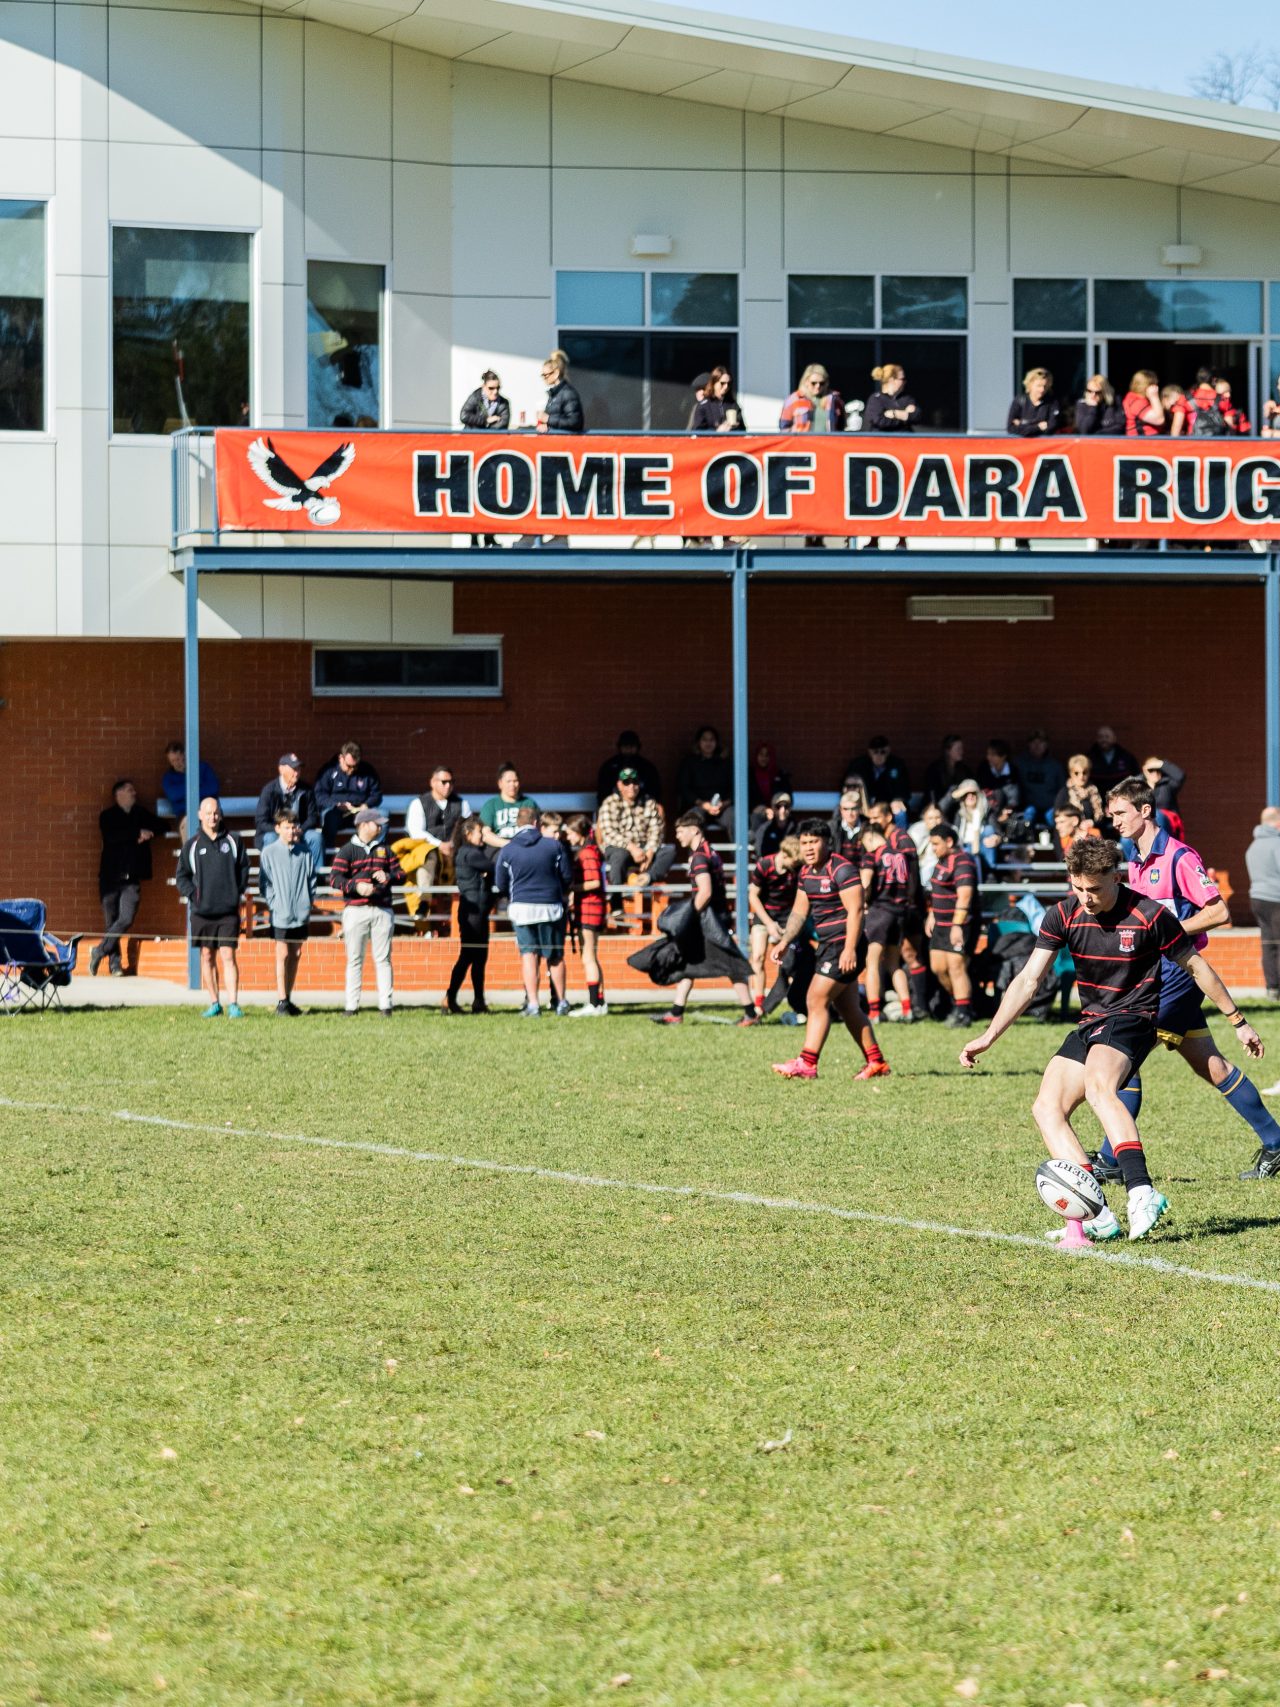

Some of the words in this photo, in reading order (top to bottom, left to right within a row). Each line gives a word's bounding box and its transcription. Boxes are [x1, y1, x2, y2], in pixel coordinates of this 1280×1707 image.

[412, 450, 675, 520] HOME
[702, 450, 817, 520] OF
[844, 453, 1087, 522] DARA
[1054, 1160, 1103, 1200] GILBERT
